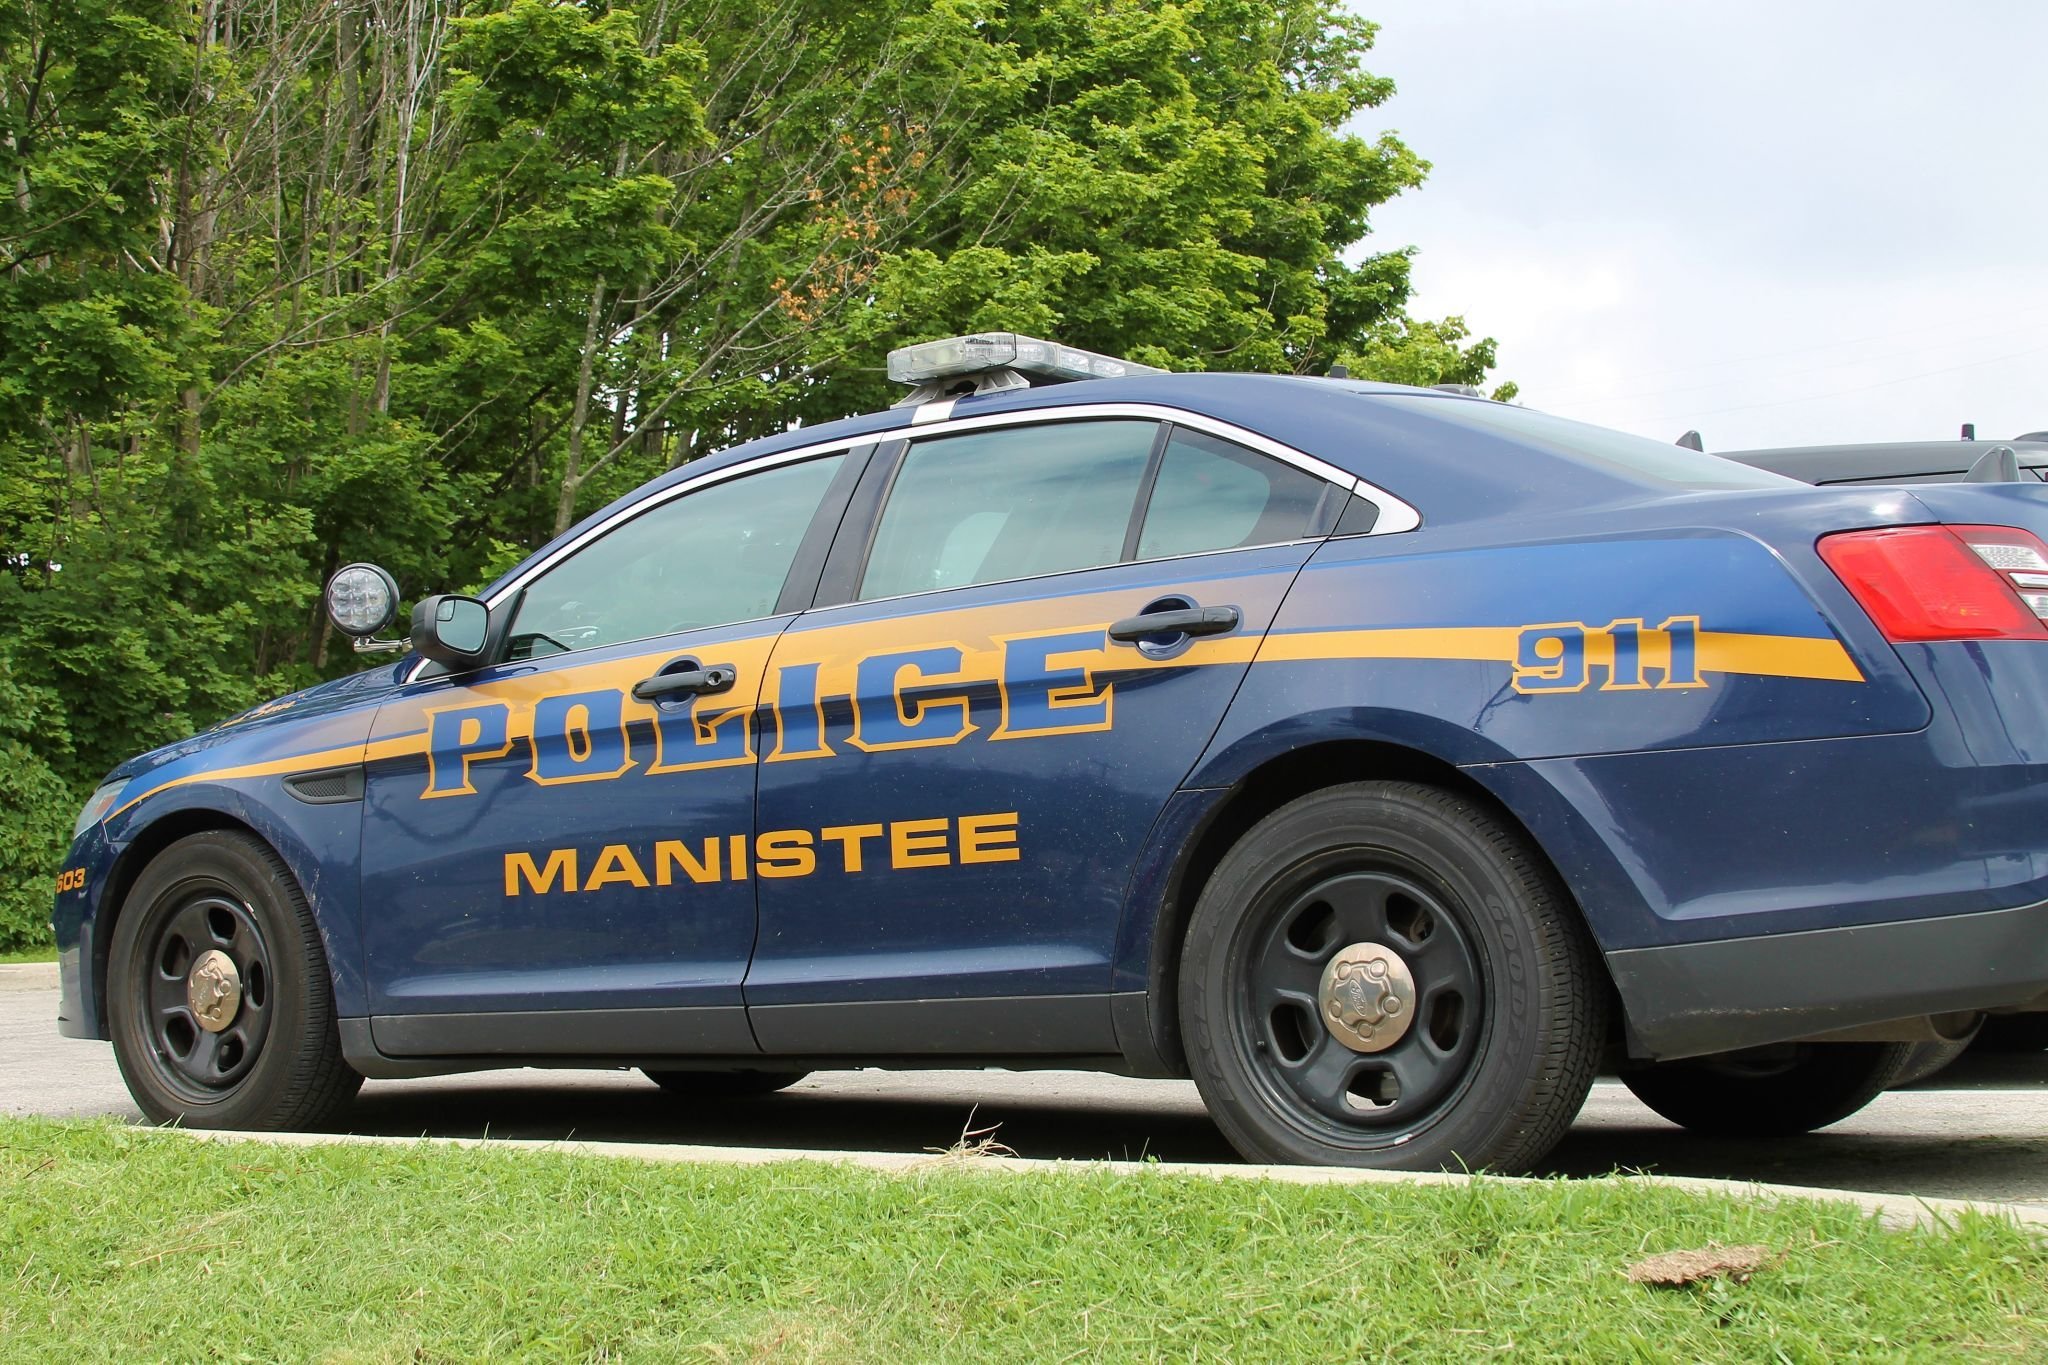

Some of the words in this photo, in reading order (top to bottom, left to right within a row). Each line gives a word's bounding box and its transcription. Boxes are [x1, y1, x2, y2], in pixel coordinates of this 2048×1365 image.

[1511, 615, 1709, 695] 911
[420, 628, 1115, 800] POLICE
[502, 811, 1020, 896] MANISTEE
